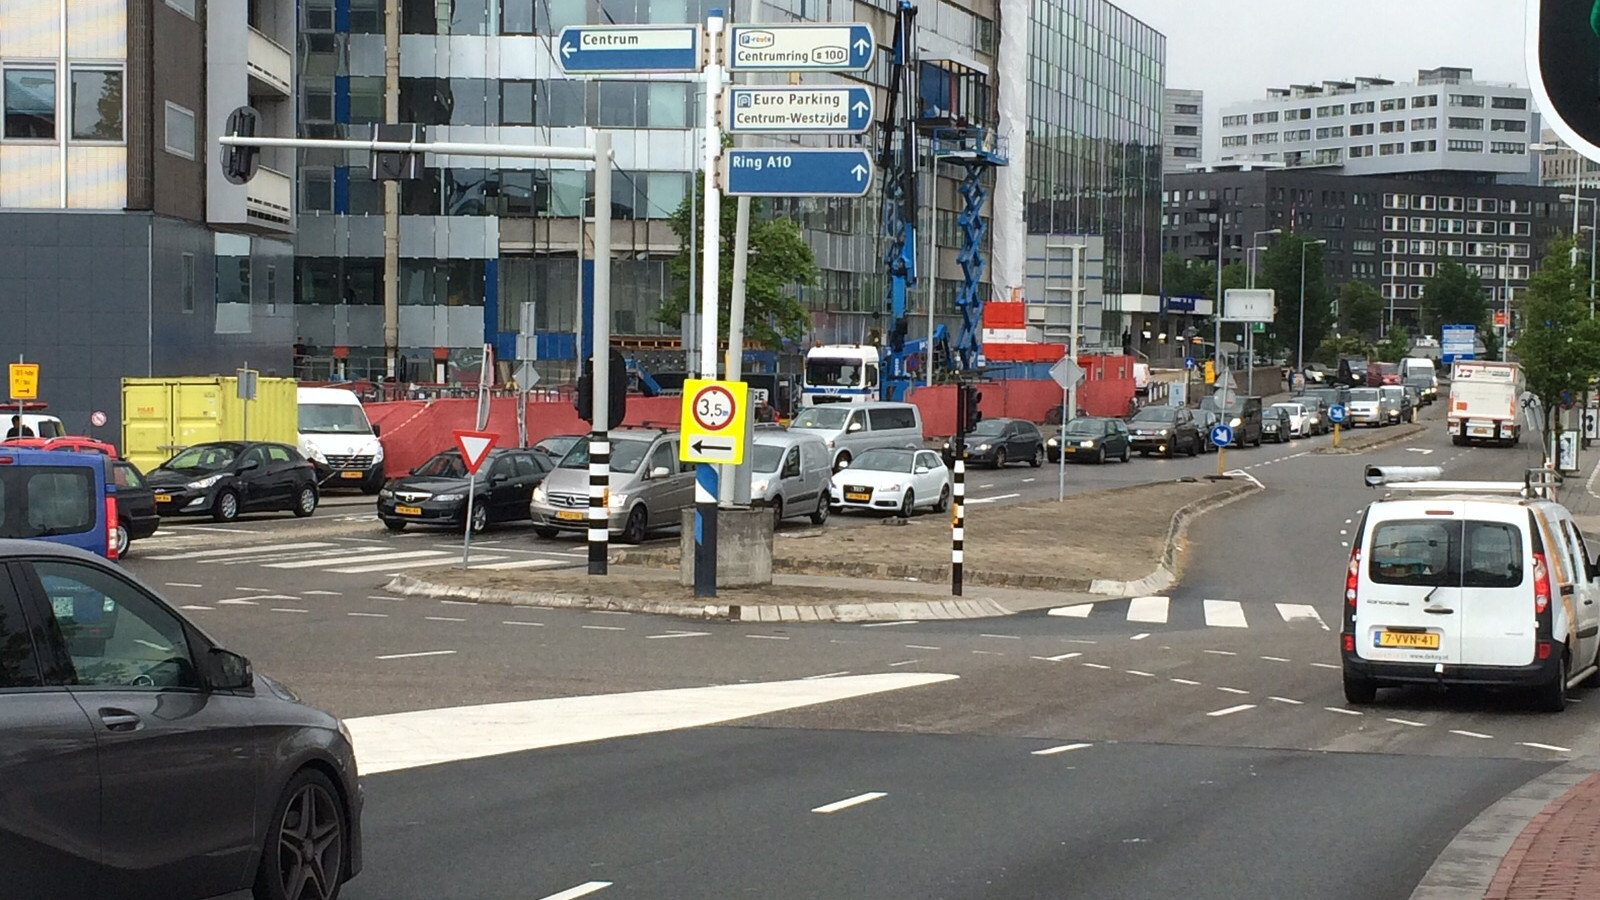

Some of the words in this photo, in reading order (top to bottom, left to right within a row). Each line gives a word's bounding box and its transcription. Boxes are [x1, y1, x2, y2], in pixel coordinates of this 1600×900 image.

[582, 33, 639, 45] Centrum
[737, 50, 809, 63] Centrumring
[825, 50, 844, 60] 100
[753, 93, 784, 105] Euro
[789, 93, 840, 108] Parking
[736, 112, 847, 126] Centrum-Westzijde
[733, 155, 762, 171] Ring
[766, 155, 792, 168] A10
[1385, 633, 1434, 646] 7-VVN-41
